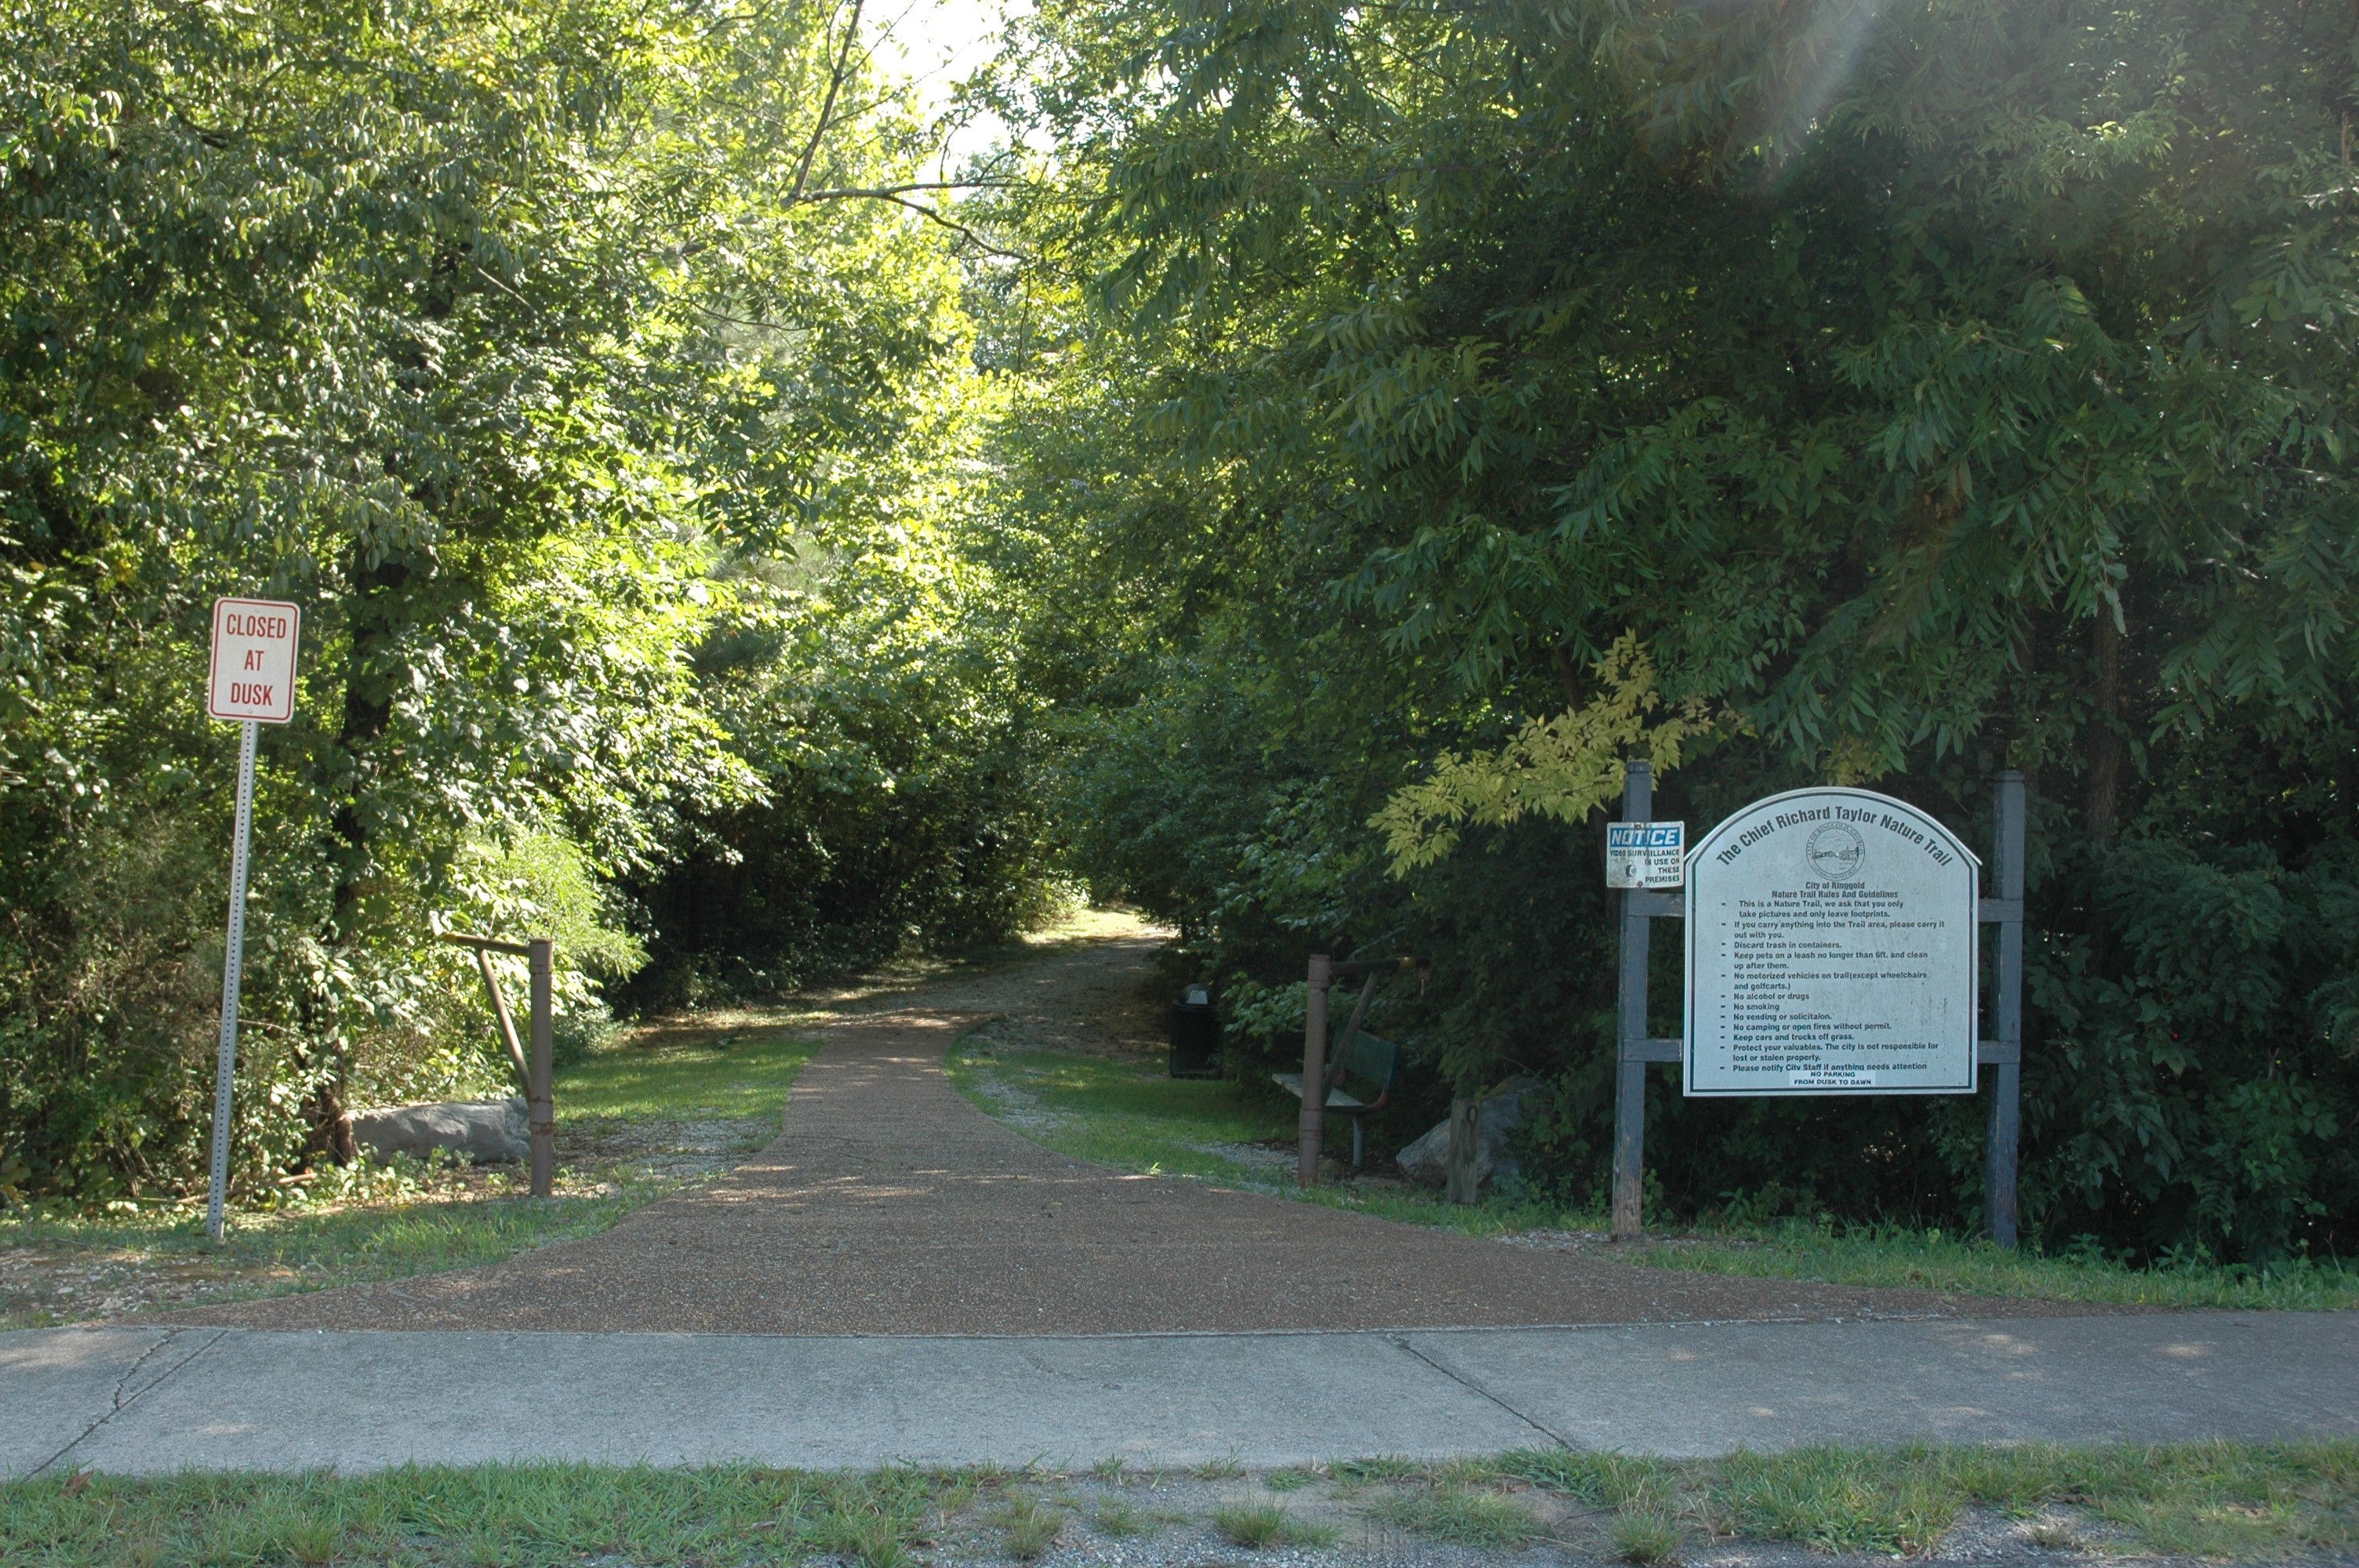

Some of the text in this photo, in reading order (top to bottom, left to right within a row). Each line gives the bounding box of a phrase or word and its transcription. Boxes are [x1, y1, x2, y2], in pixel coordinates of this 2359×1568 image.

[227, 614, 286, 639] CLOSED
[244, 649, 264, 670] AT
[231, 683, 273, 706] DUSK
[1612, 829, 1677, 845] NOTICE
[1716, 844, 1741, 866] The
[1739, 820, 1775, 847] Chief
[1776, 806, 1830, 829] Richard
[1835, 806, 1877, 824] Taylor
[1880, 814, 1924, 844] Nature
[1924, 838, 1953, 866] Trail
[1805, 881, 1819, 890] City
[1758, 910, 1790, 919] pictures
[1889, 920, 1915, 929] please
[1787, 1054, 1820, 1062] property.
[1761, 1064, 1783, 1073] notify
